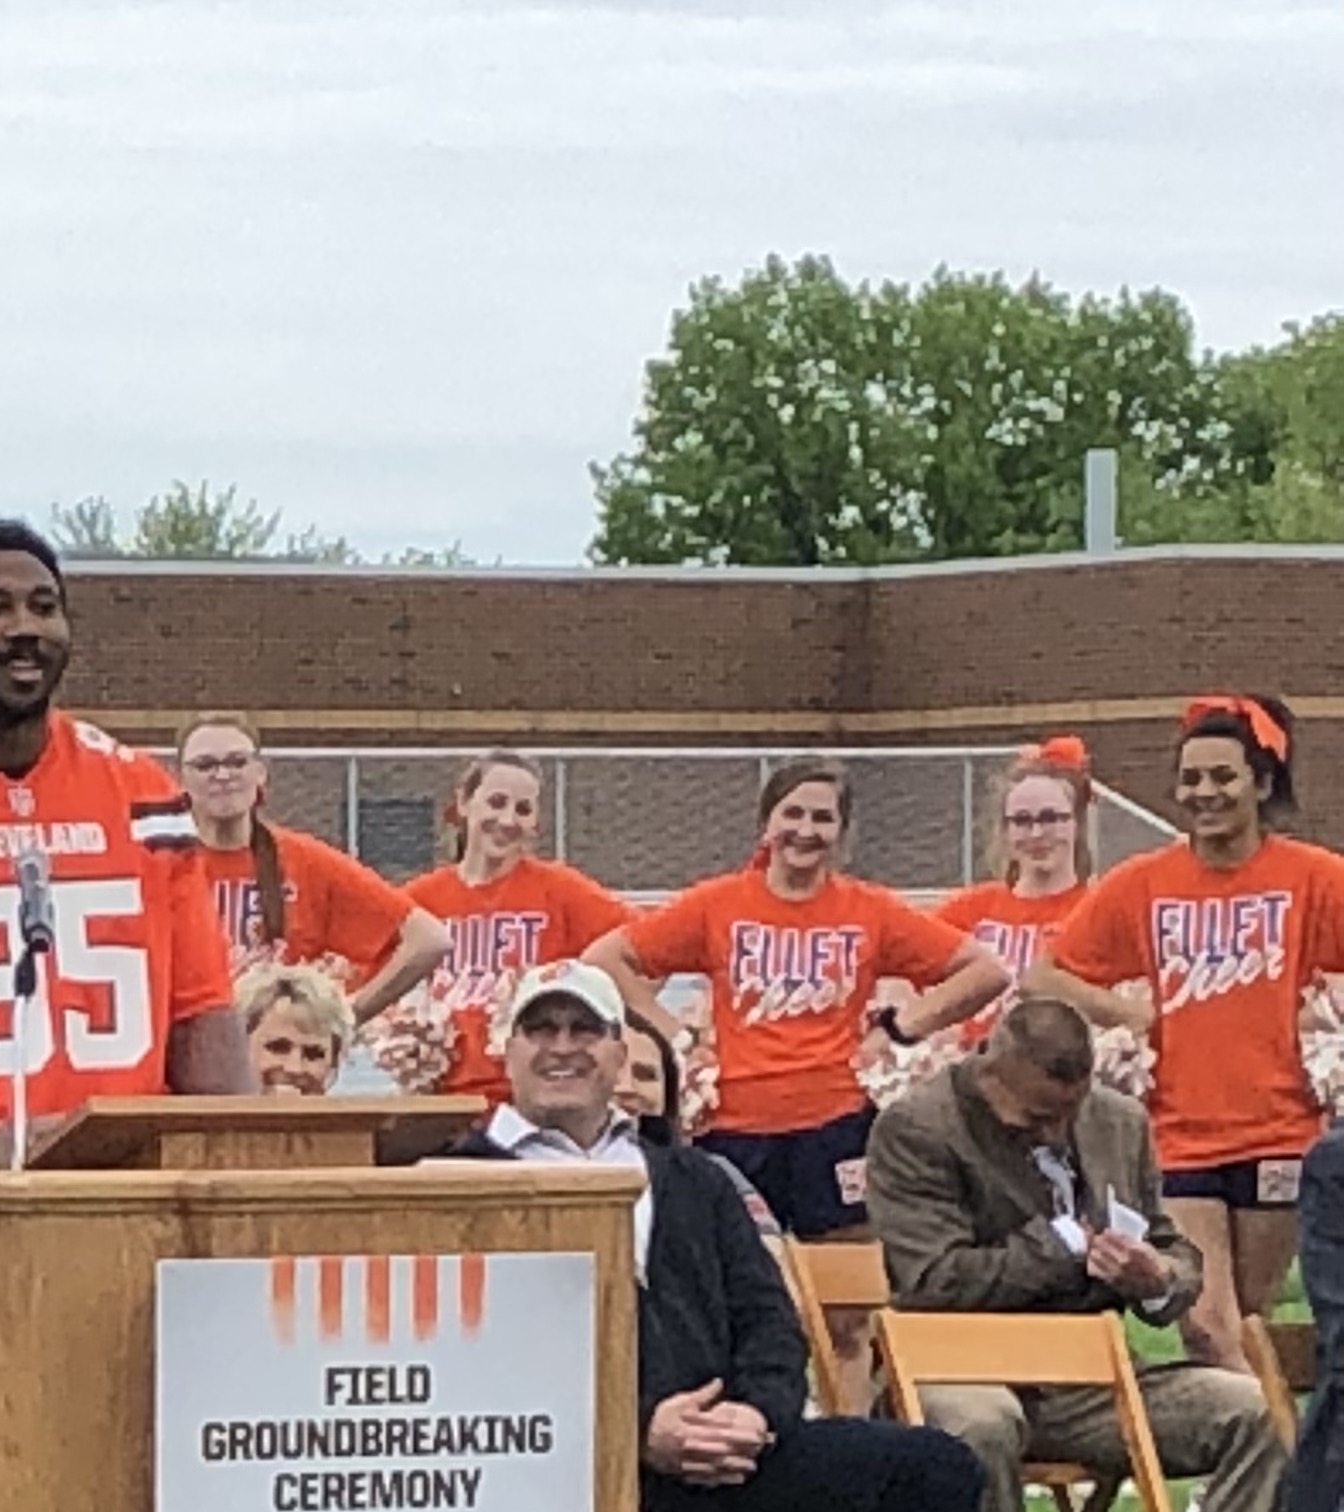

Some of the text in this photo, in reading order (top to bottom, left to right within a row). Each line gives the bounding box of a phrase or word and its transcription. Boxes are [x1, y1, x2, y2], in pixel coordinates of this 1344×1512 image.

[729, 920, 865, 990] ELLET
[1152, 890, 1292, 968] ELLET
[1159, 944, 1286, 1016] Cheer
[324, 1364, 432, 1406] FIELD
[201, 1414, 553, 1461] GROUNDBREAKING
[272, 1467, 482, 1512] CEREMONY
